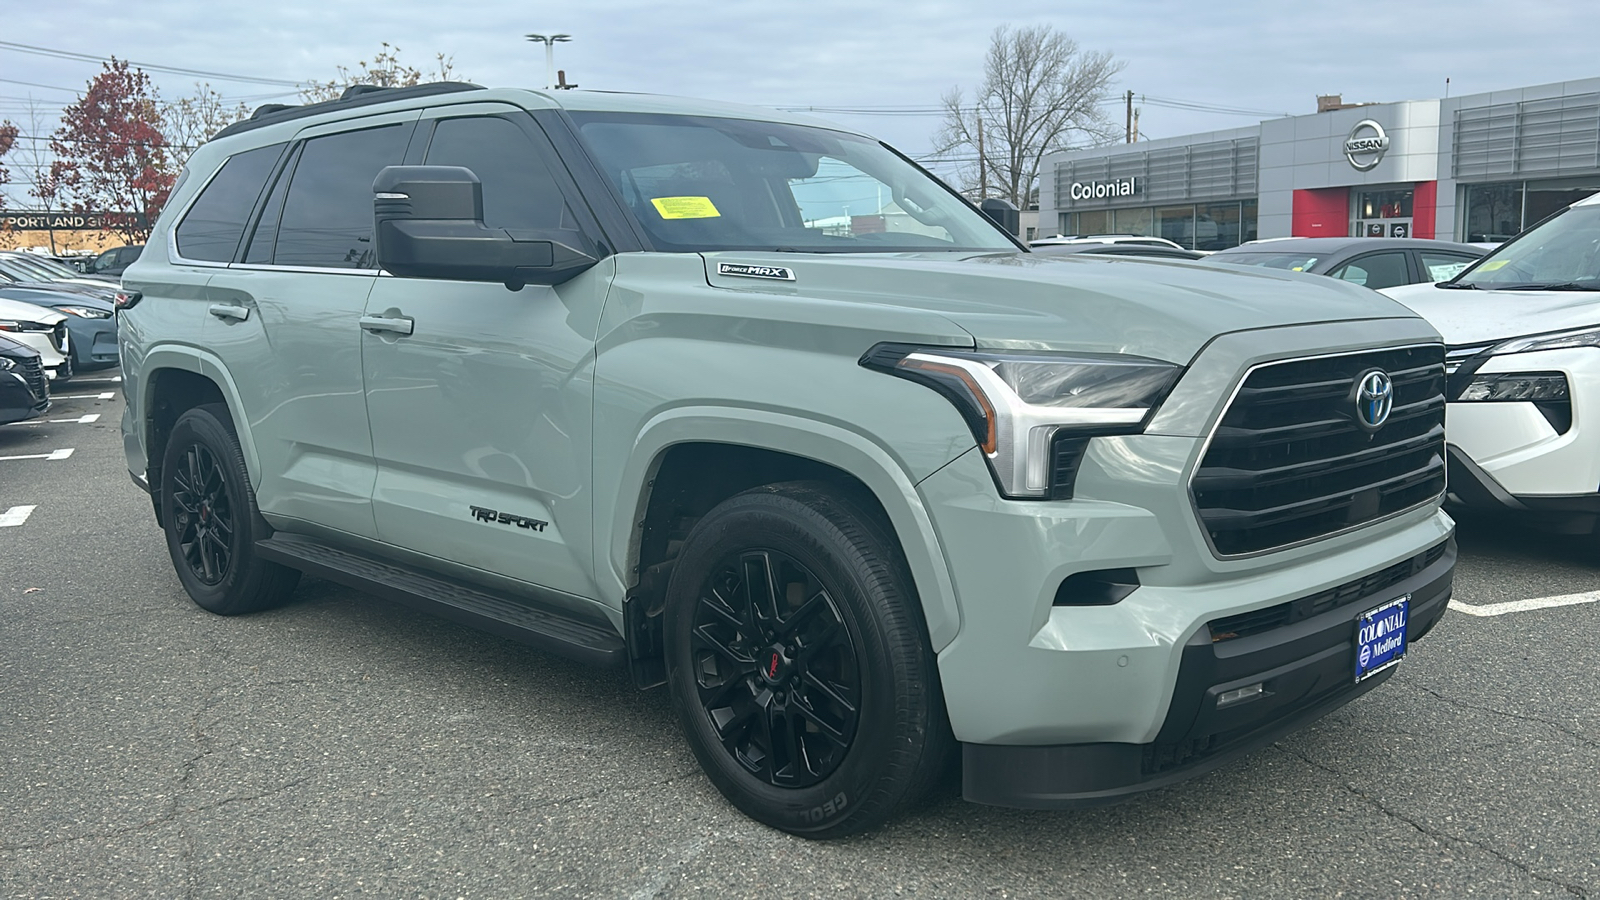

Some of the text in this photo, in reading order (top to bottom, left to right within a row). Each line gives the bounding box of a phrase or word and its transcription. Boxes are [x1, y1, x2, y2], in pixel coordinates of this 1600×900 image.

[1346, 140, 1383, 151] NISSAN
[1070, 177, 1135, 201] Colonial
[469, 505, 549, 533] TRD SPORT
[1372, 632, 1403, 658] Medford
